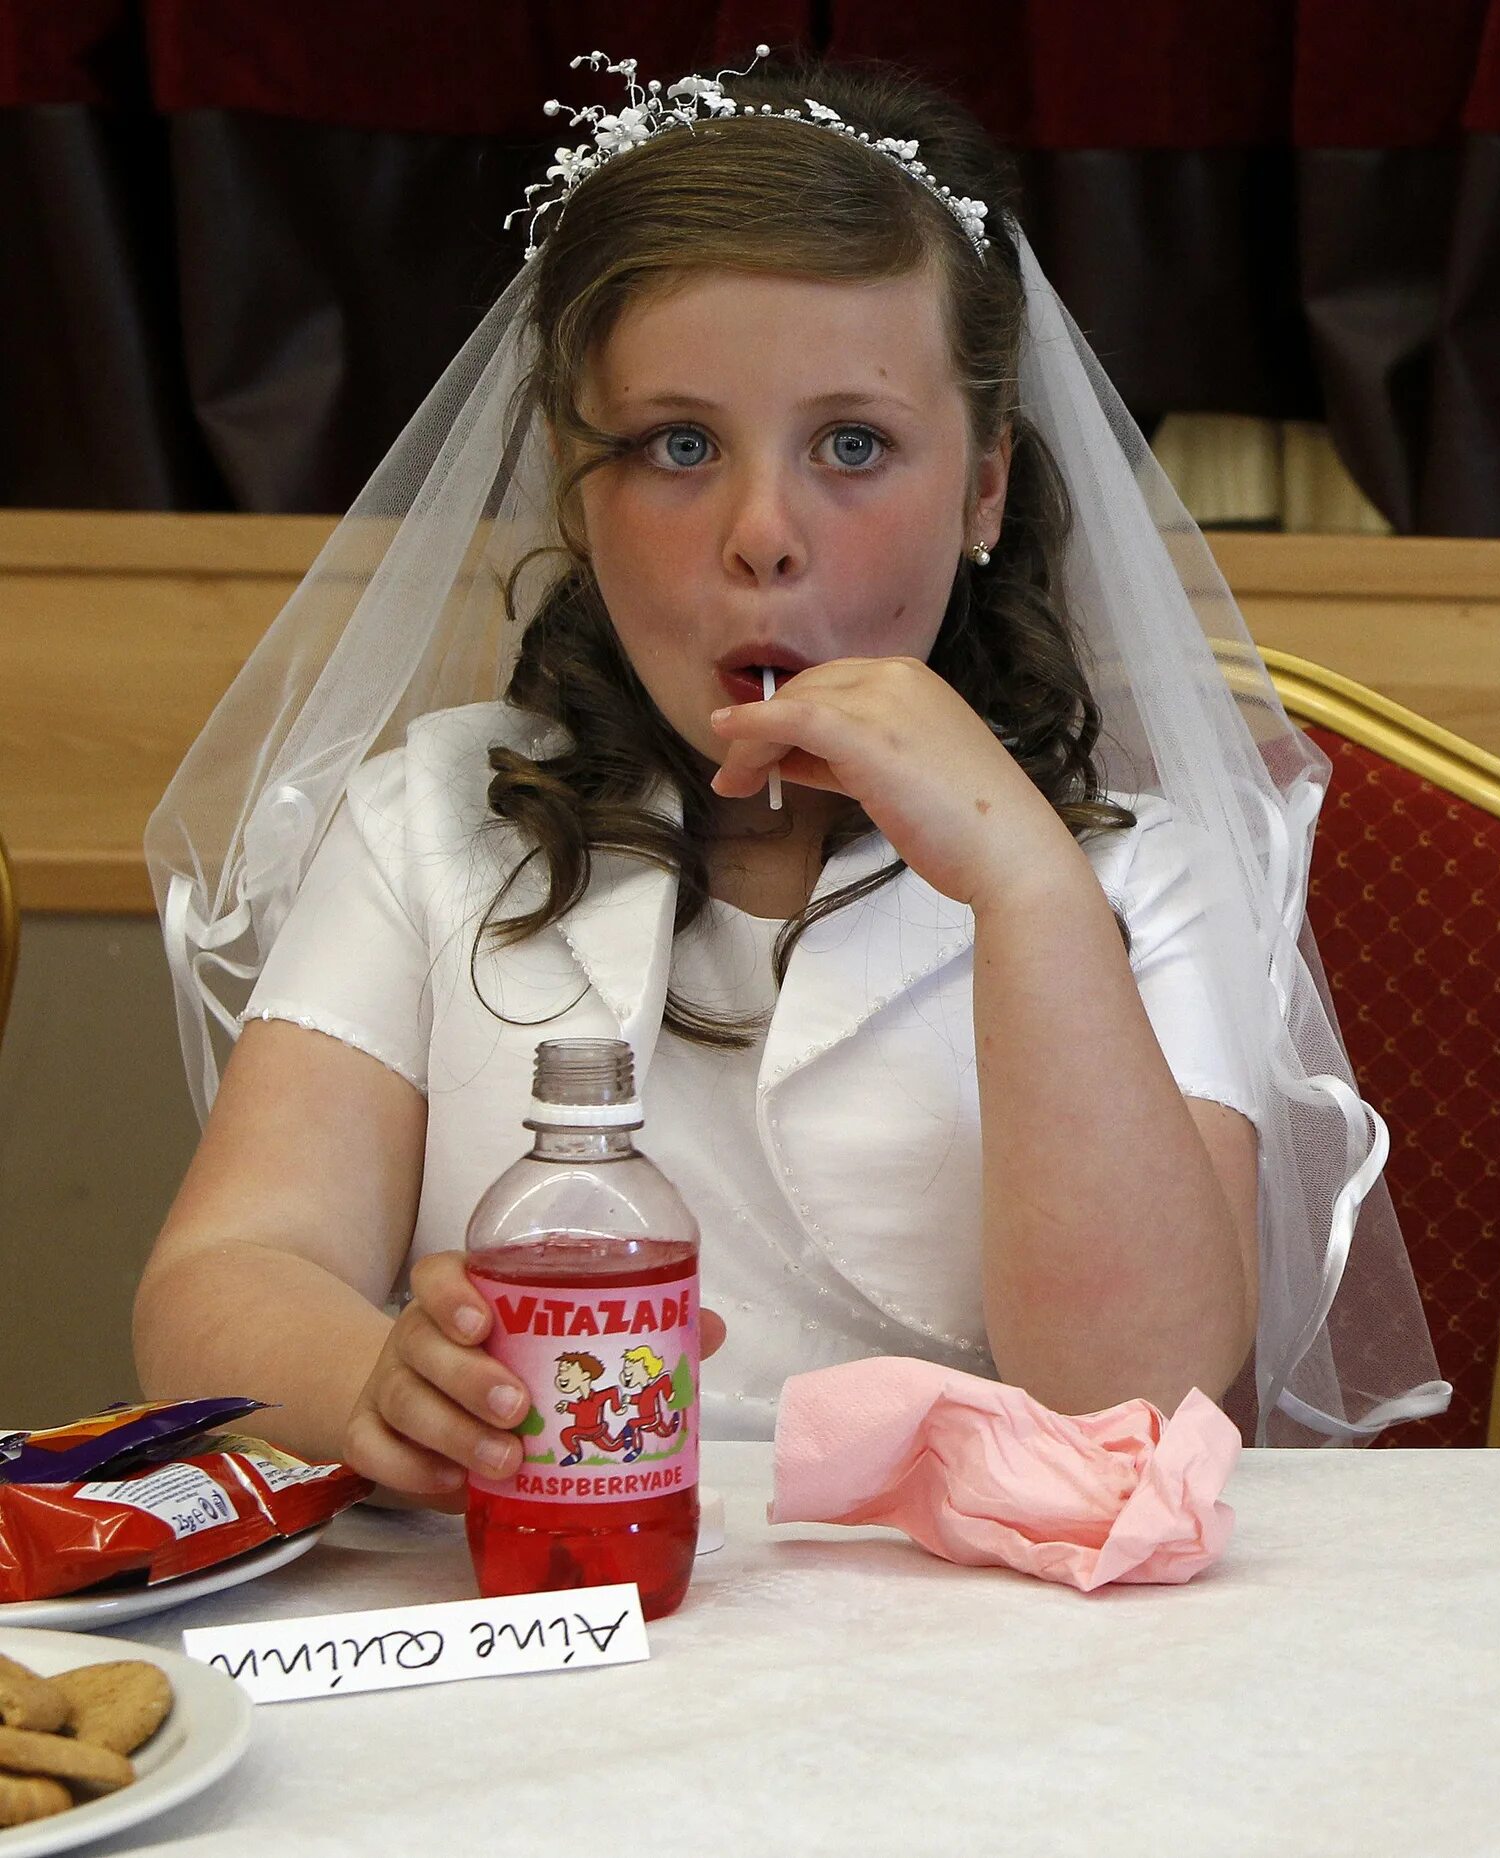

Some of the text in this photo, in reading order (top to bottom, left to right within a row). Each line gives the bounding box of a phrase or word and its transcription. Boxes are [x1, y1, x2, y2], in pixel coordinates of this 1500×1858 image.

[495, 1290, 691, 1337] VITAZADE
[516, 1466, 683, 1497] RASPBERRYADE
[171, 1513, 197, 1532] 25g
[210, 1630, 444, 1688] Quinn
